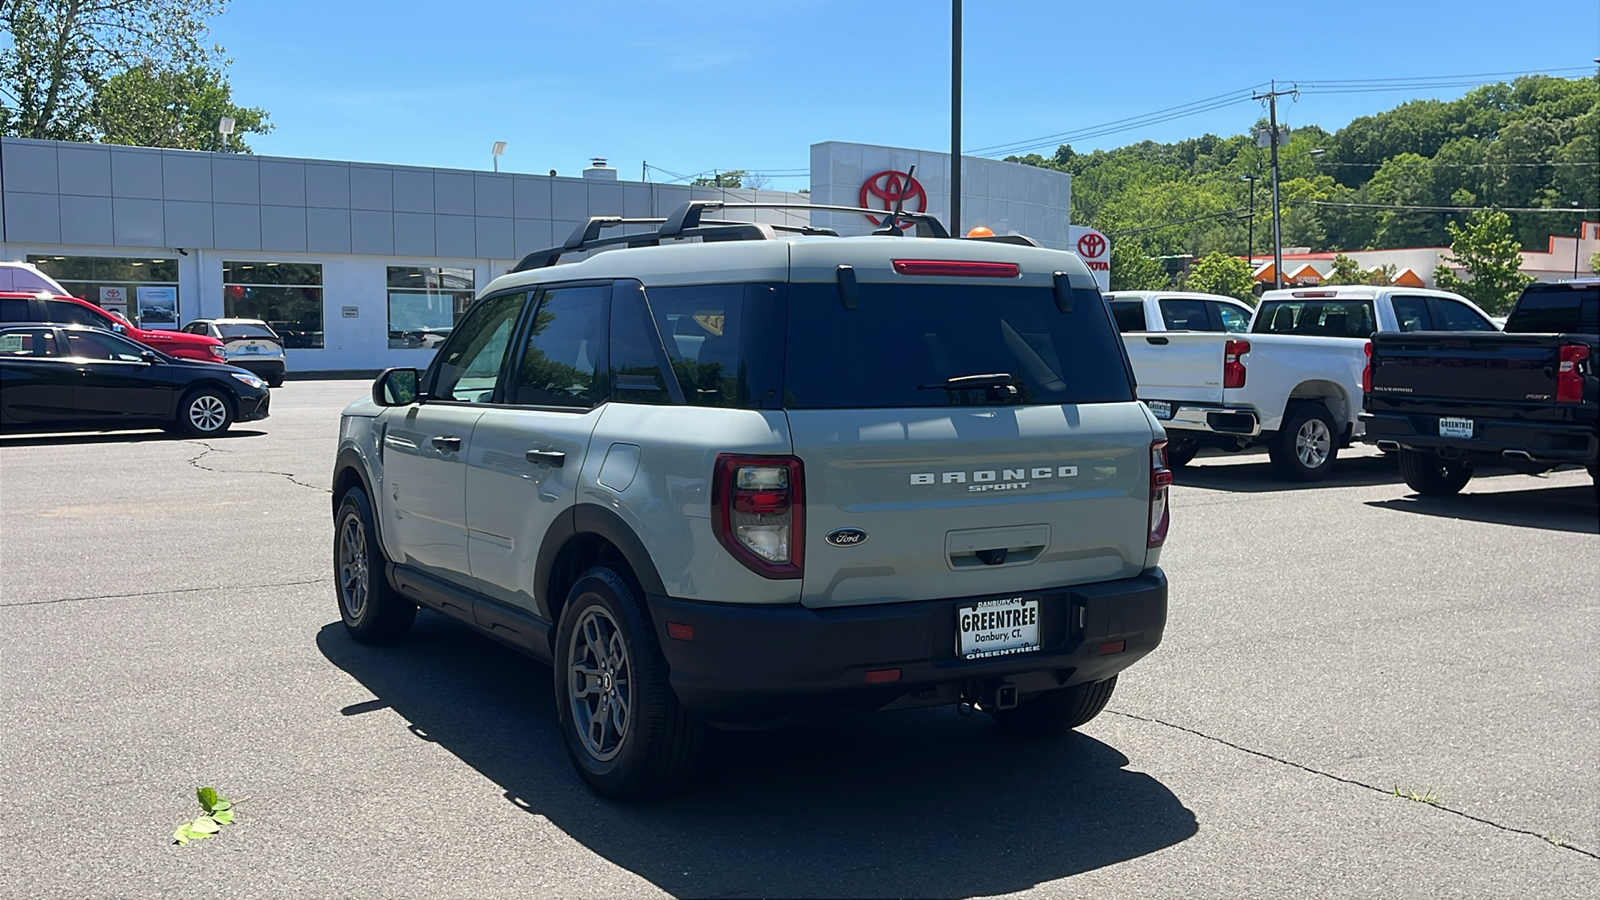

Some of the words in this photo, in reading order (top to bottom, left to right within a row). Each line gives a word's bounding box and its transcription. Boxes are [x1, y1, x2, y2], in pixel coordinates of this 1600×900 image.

[1086, 261, 1109, 271] YOTA
[1440, 420, 1473, 430] GREENTREE
[910, 466, 1078, 485] BRONCO
[968, 482, 1029, 492] SPORT
[835, 531, 860, 543] Ford
[961, 607, 1036, 632] GREENTREE
[975, 631, 1010, 643] Danbury,
[1011, 629, 1022, 639] CT.
[966, 645, 1040, 660] GREENTREE
